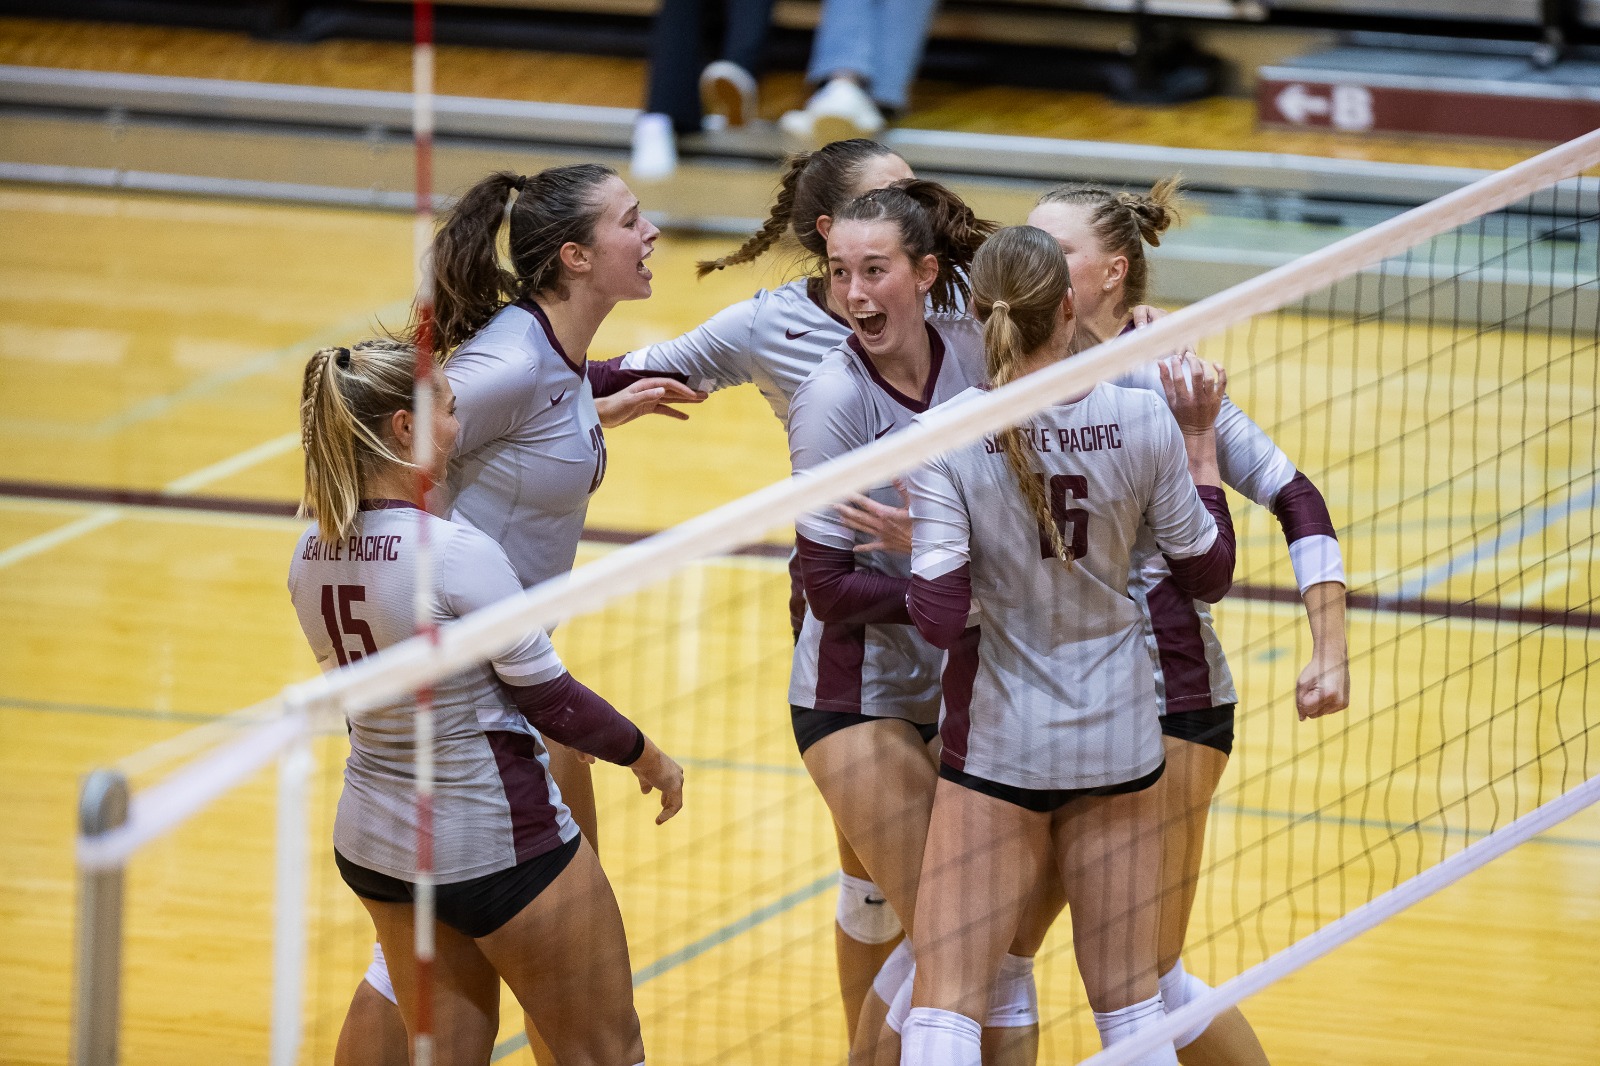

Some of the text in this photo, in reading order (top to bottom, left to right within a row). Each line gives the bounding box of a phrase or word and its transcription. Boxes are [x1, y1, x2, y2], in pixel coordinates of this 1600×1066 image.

[1332, 84, 1374, 132] B
[1058, 423, 1122, 453] PACIFIC
[349, 535, 402, 562] PACIFIC
[321, 584, 380, 668] 15
